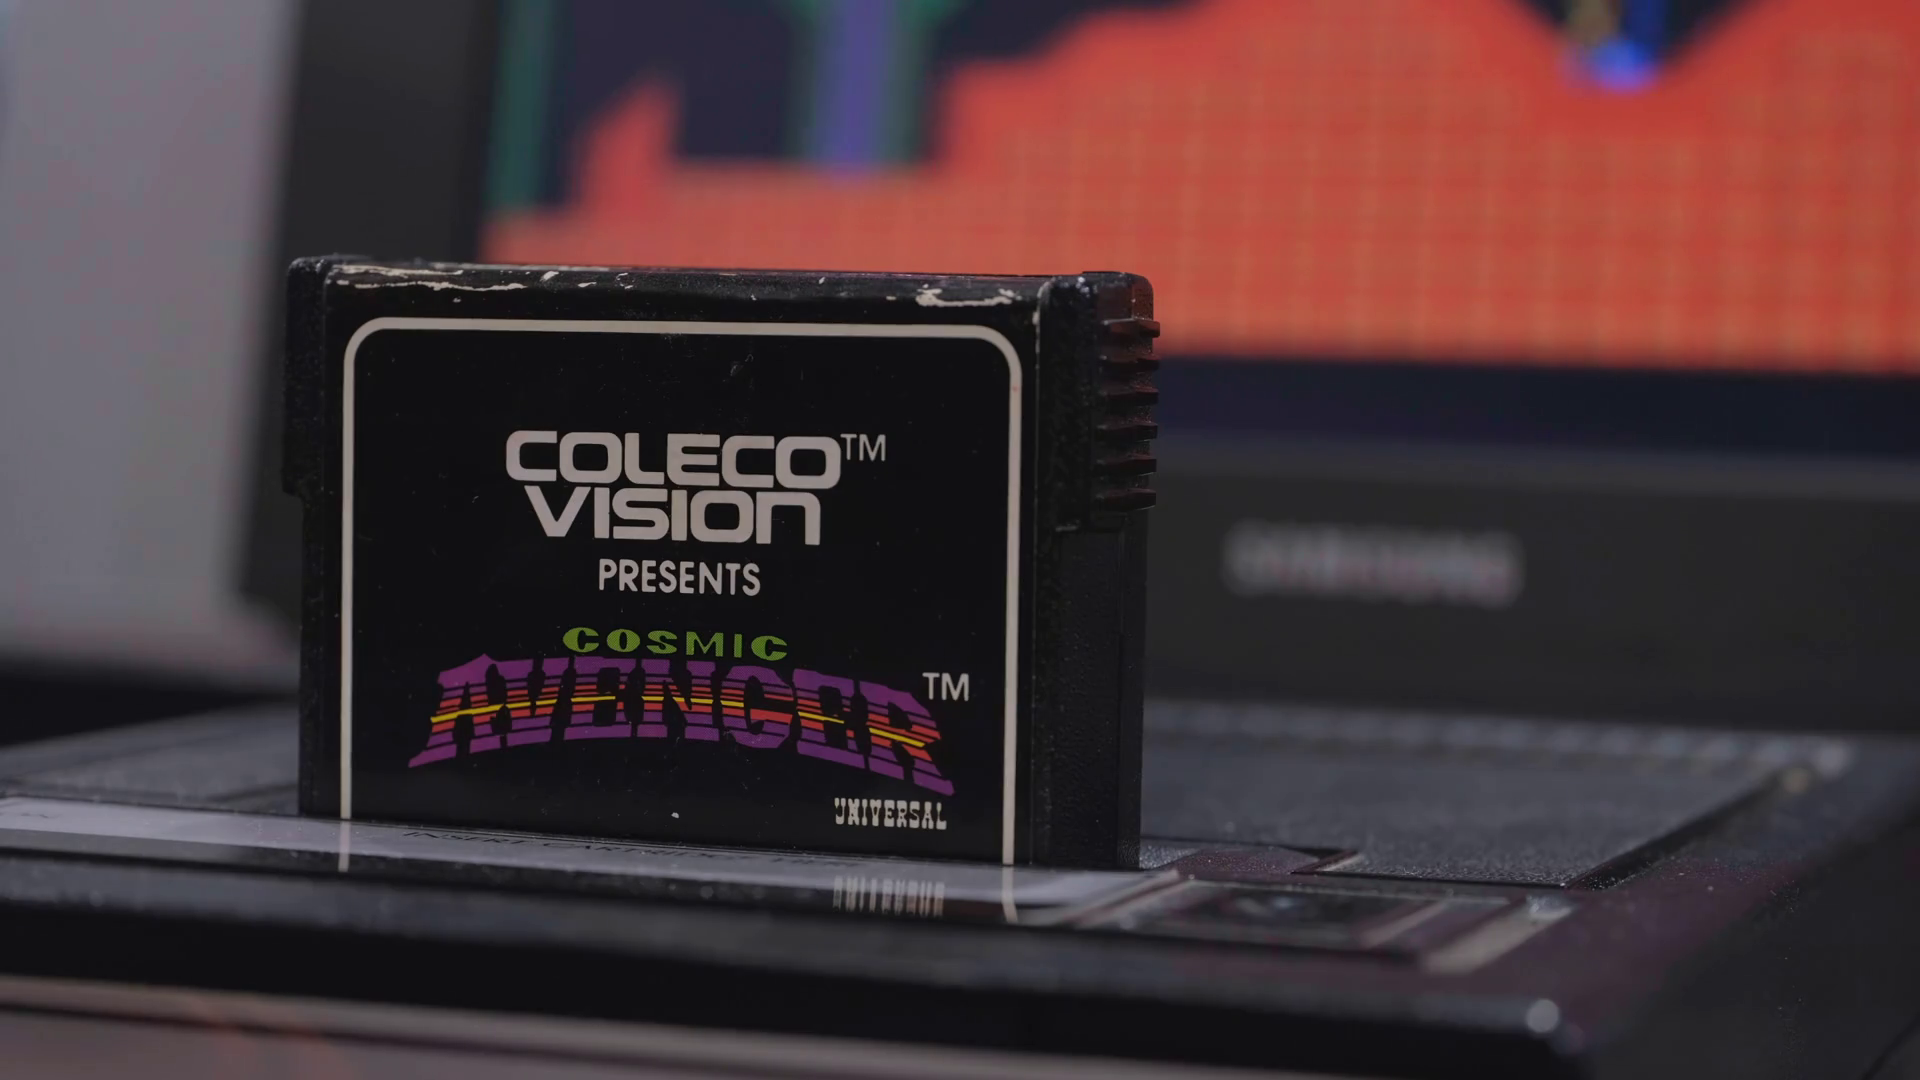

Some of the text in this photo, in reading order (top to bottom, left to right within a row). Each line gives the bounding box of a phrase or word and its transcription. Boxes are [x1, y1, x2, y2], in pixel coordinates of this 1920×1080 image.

[506, 430, 887, 489] COLECO TM
[524, 485, 821, 546] VISION
[598, 558, 761, 597] PRESENTS
[562, 627, 788, 661] COSMIC
[408, 654, 970, 796] AVENGER TM
[834, 797, 947, 830] UNIVERSAL
